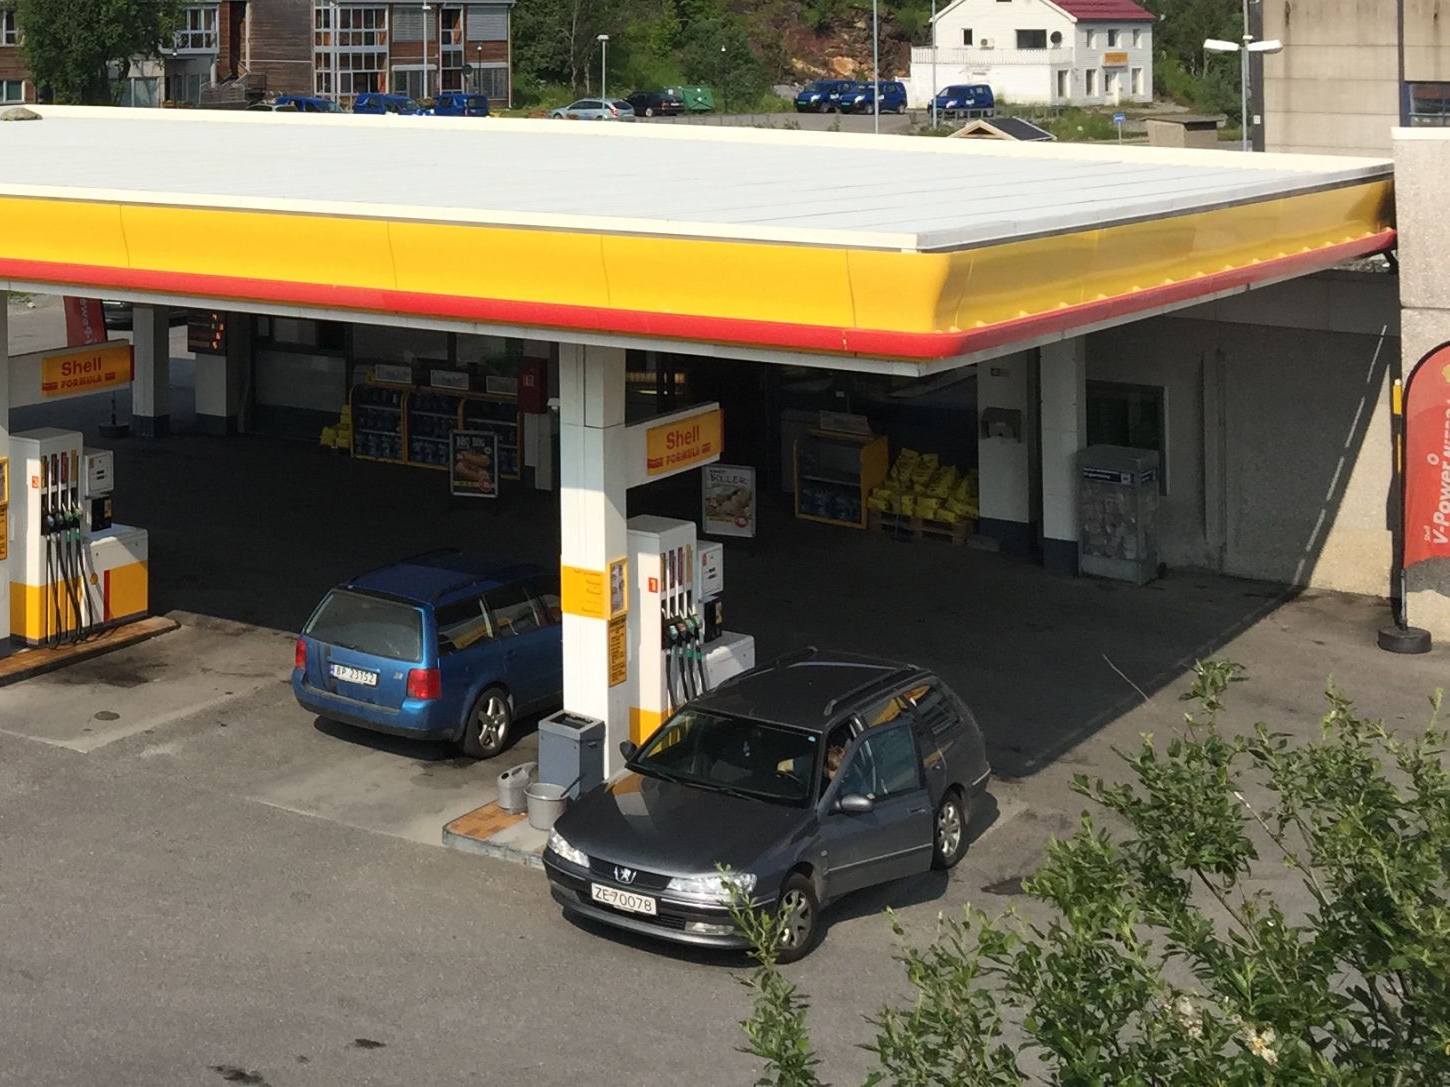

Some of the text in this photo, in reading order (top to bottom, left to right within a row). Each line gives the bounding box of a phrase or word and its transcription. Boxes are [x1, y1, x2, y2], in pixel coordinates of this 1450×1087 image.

[61, 357, 102, 376] Shell
[60, 375, 103, 389] FORMULA
[666, 425, 700, 450] Shell
[665, 447, 700, 465] FORMULA
